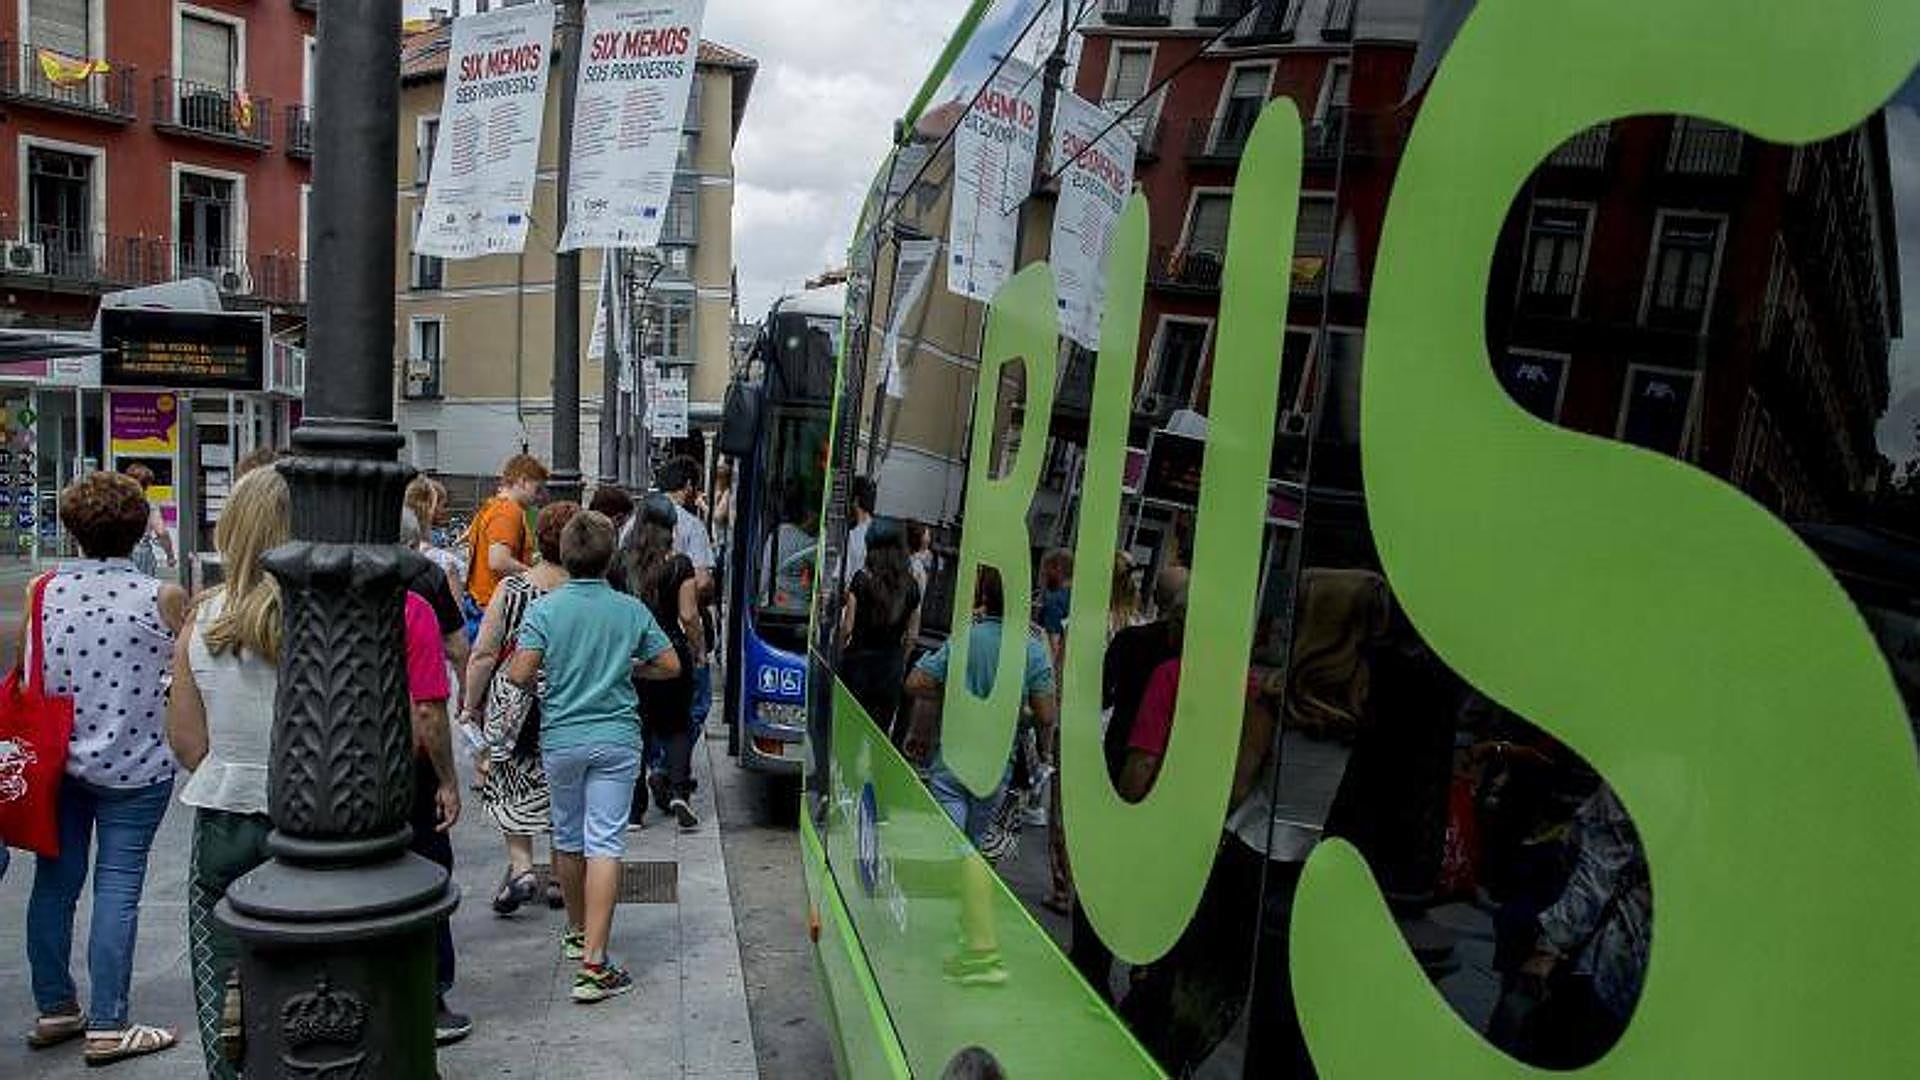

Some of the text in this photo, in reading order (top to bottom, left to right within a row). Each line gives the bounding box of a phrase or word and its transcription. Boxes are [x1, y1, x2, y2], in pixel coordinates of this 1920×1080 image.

[459, 43, 541, 82] SIX MEMOS
[591, 26, 690, 60] SIX MEMOS
[942, 0, 1920, 1080] BUS
